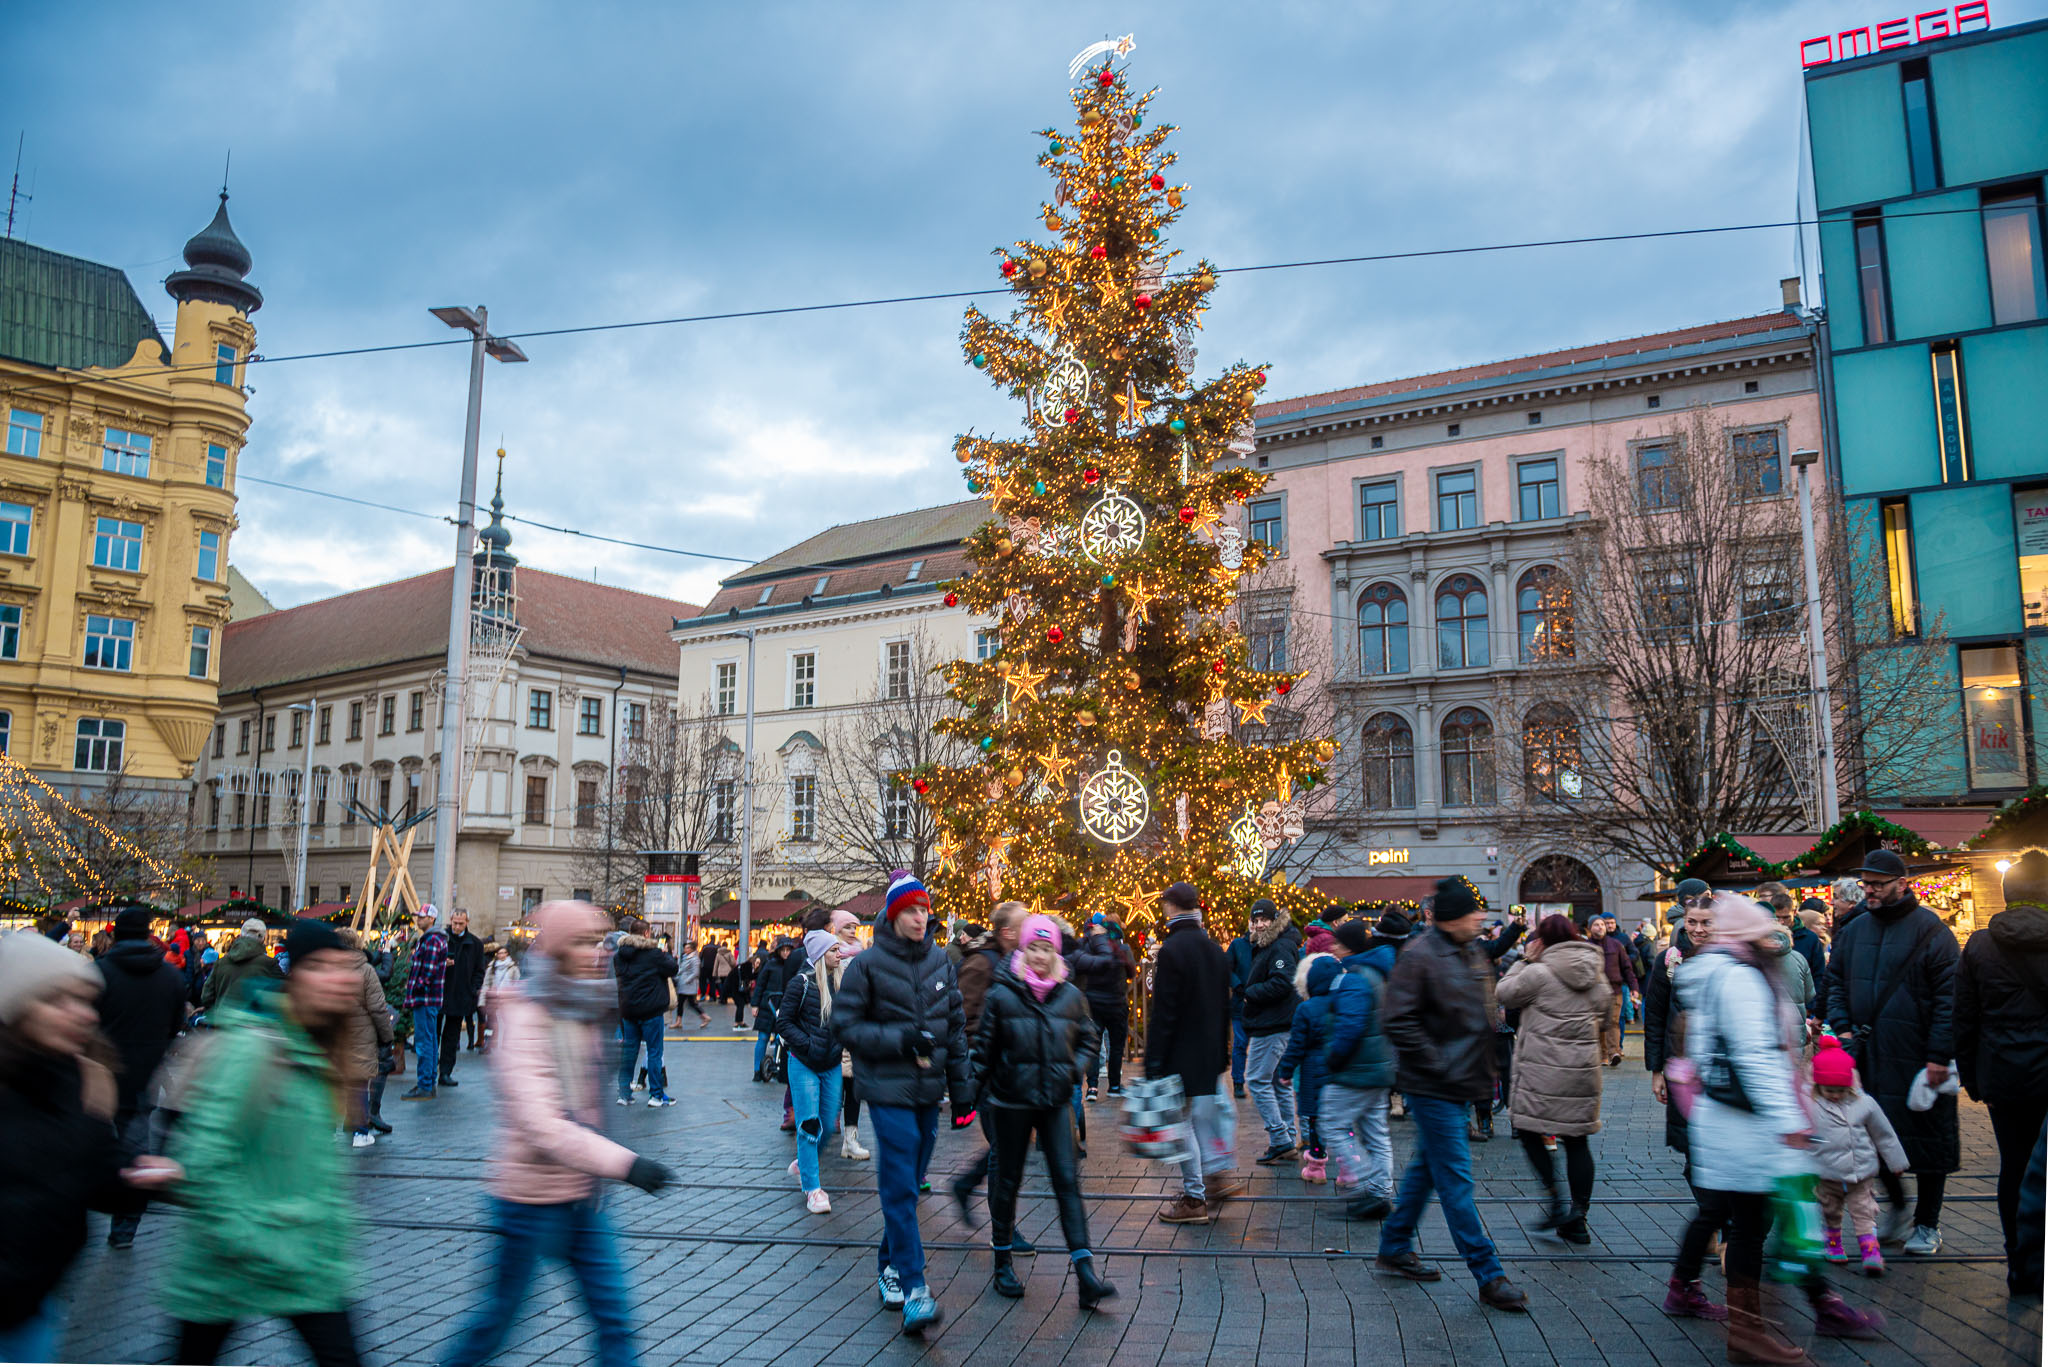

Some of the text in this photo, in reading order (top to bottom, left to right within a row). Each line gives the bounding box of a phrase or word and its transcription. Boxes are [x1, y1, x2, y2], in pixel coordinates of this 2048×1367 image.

[1800, 0, 1991, 67] OMEGA
[1946, 413, 1957, 463] GROUP
[1369, 848, 1410, 866] point
